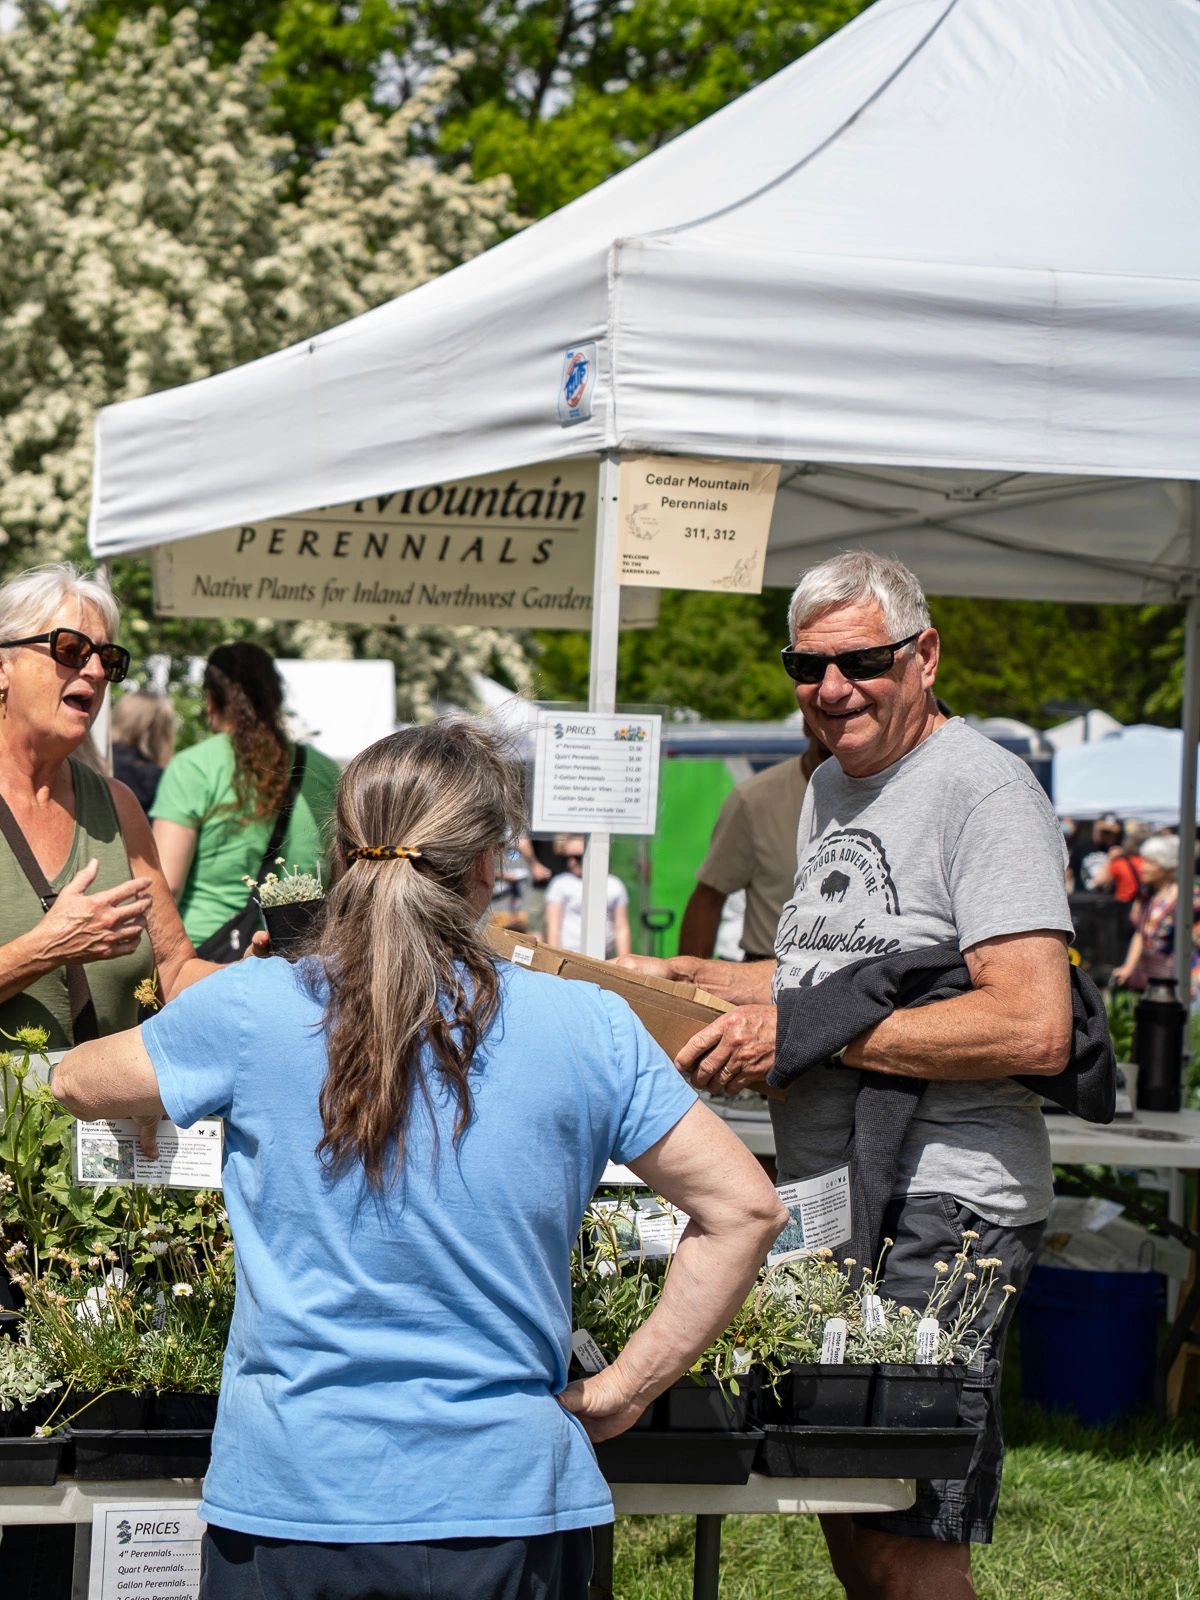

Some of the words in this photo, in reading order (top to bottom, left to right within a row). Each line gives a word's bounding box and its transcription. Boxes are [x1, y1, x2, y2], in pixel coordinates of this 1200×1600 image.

[646, 473, 684, 486] Cedar
[688, 476, 750, 491] Mountain
[661, 497, 728, 512] Perennials
[684, 527, 710, 540] 311,
[713, 529, 736, 540] 312
[237, 527, 554, 564] PERENNIALS
[192, 575, 253, 598] Native
[257, 576, 316, 601] Plants
[321, 577, 349, 610] for
[353, 581, 414, 605] Inland
[417, 584, 515, 608] Northwest
[522, 586, 594, 611] Garden
[566, 725, 596, 735] PRICES
[776, 905, 901, 956] Yellowstone
[134, 1522, 180, 1535] PRICES
[131, 1549, 172, 1558] Perennials
[118, 1565, 141, 1575] Quart
[143, 1564, 184, 1573] Perennials
[117, 1581, 142, 1590] Gallon
[145, 1579, 186, 1588] Perennials
